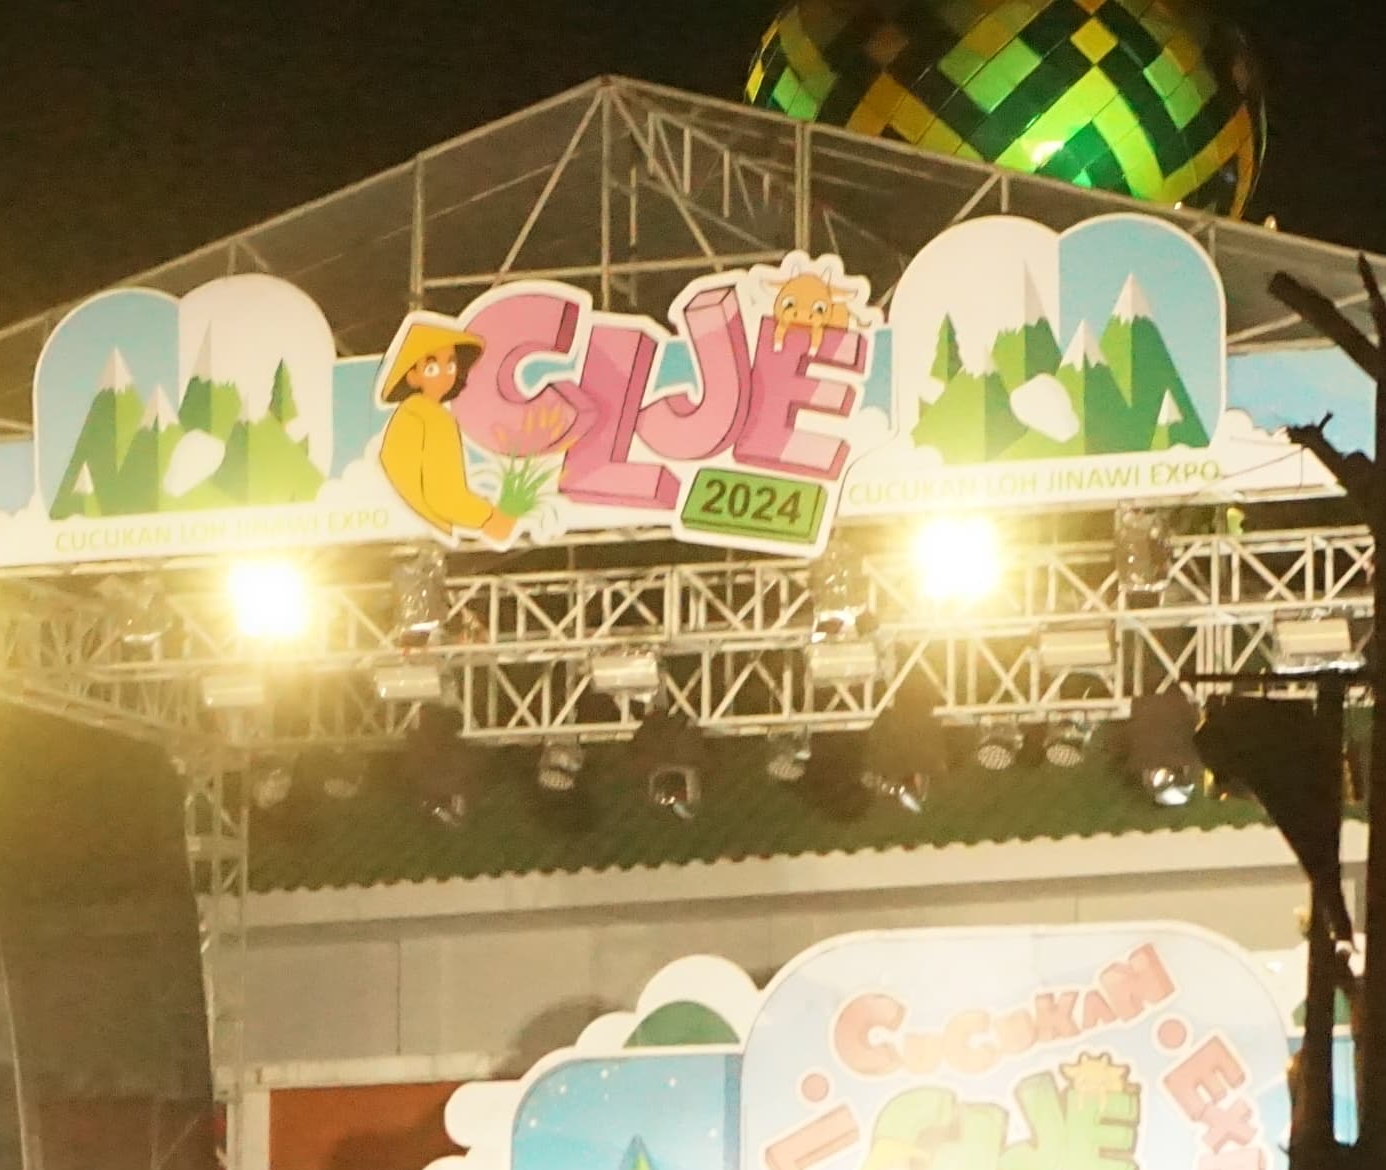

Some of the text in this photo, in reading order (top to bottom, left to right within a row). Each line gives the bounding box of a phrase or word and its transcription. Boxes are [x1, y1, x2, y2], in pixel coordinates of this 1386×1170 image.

[701, 479, 802, 525] 2024
[849, 460, 1221, 506] CUCUKAN LOH JINAWI EXPO
[55, 526, 172, 553] CUCUKAN
[179, 520, 228, 543] LOH
[327, 509, 390, 533] EXPO
